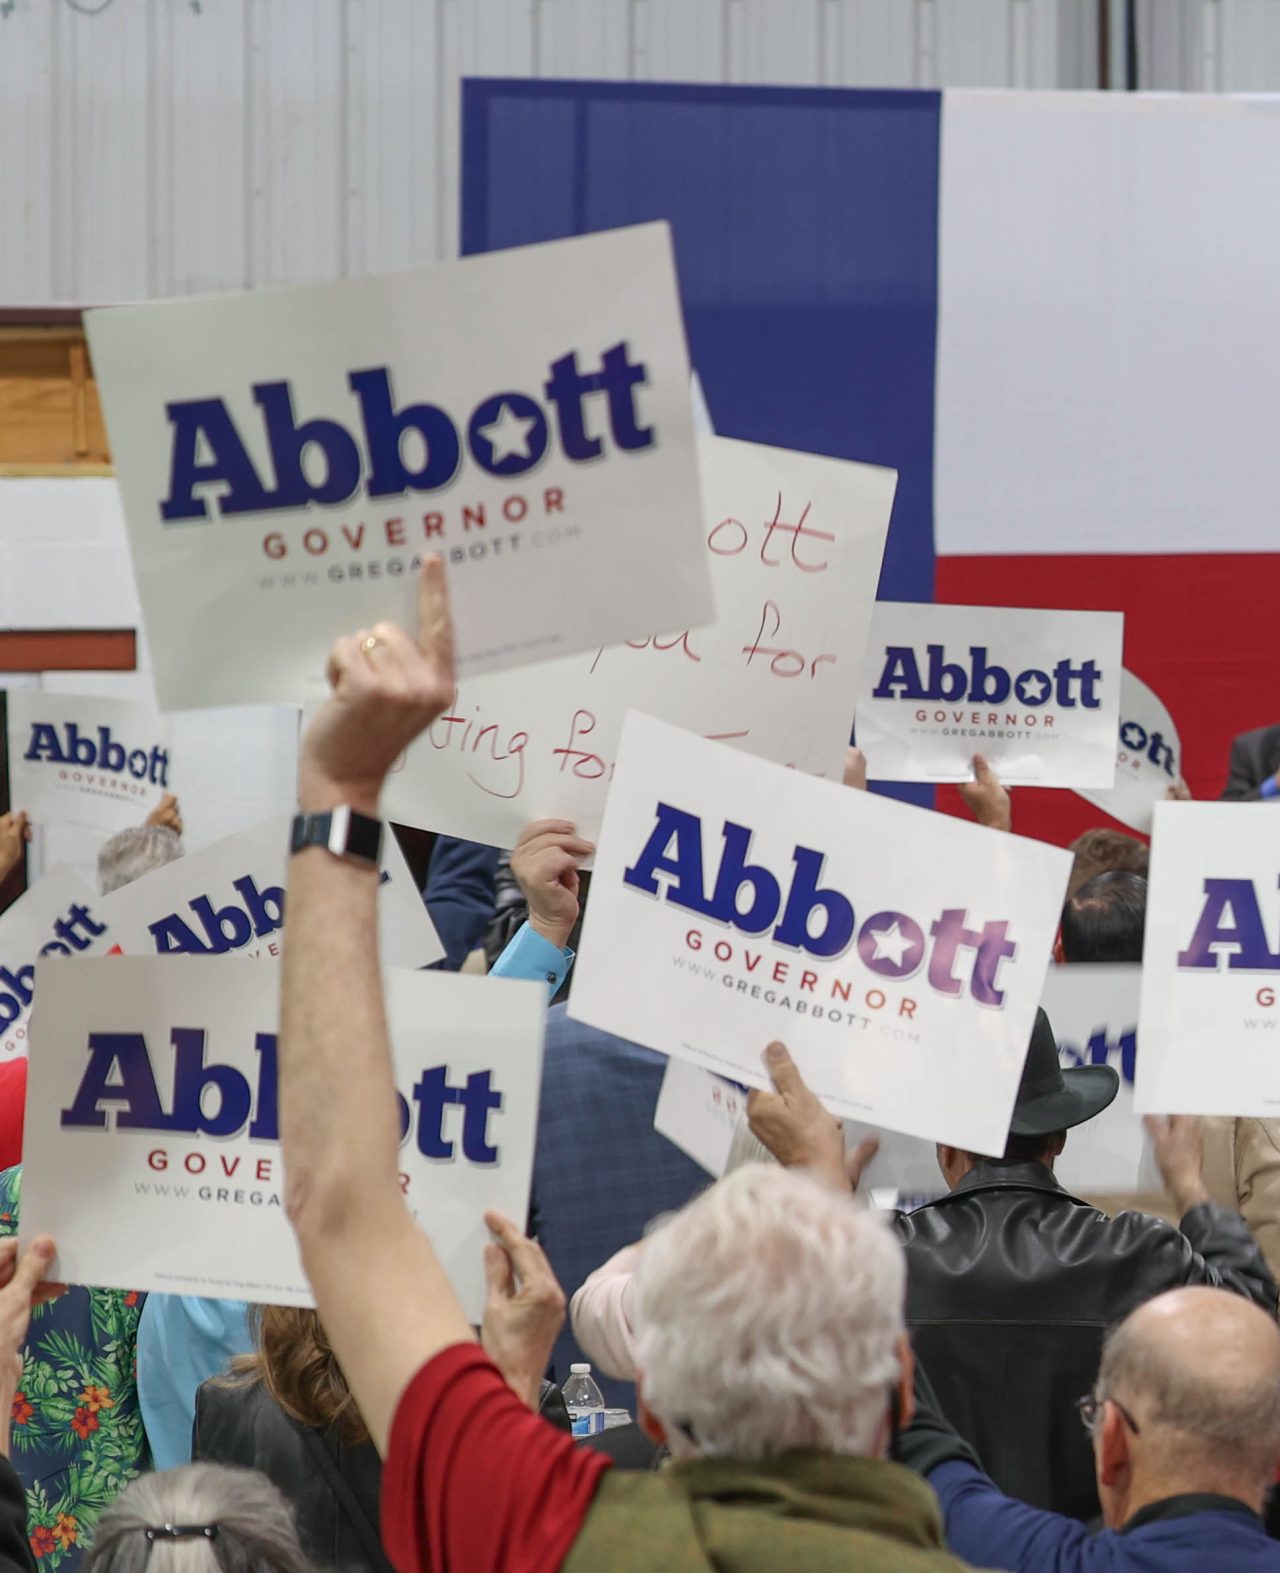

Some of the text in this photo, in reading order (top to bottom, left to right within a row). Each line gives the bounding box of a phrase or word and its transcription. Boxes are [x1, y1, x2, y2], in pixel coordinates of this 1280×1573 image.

[158, 340, 656, 525] Abbott
[258, 525, 581, 591] WWW.GREGABOTT.COM
[262, 488, 566, 560] GOVERNOR
[741, 600, 837, 679] for
[873, 645, 1101, 709] Abbott
[23, 721, 170, 788] Abbott
[916, 709, 1056, 727] GOVERNOR
[622, 801, 1018, 1009] Abbott
[672, 954, 922, 1044] WWW.GREGABBOTT.COM
[686, 929, 919, 1021] GOVERNOR
